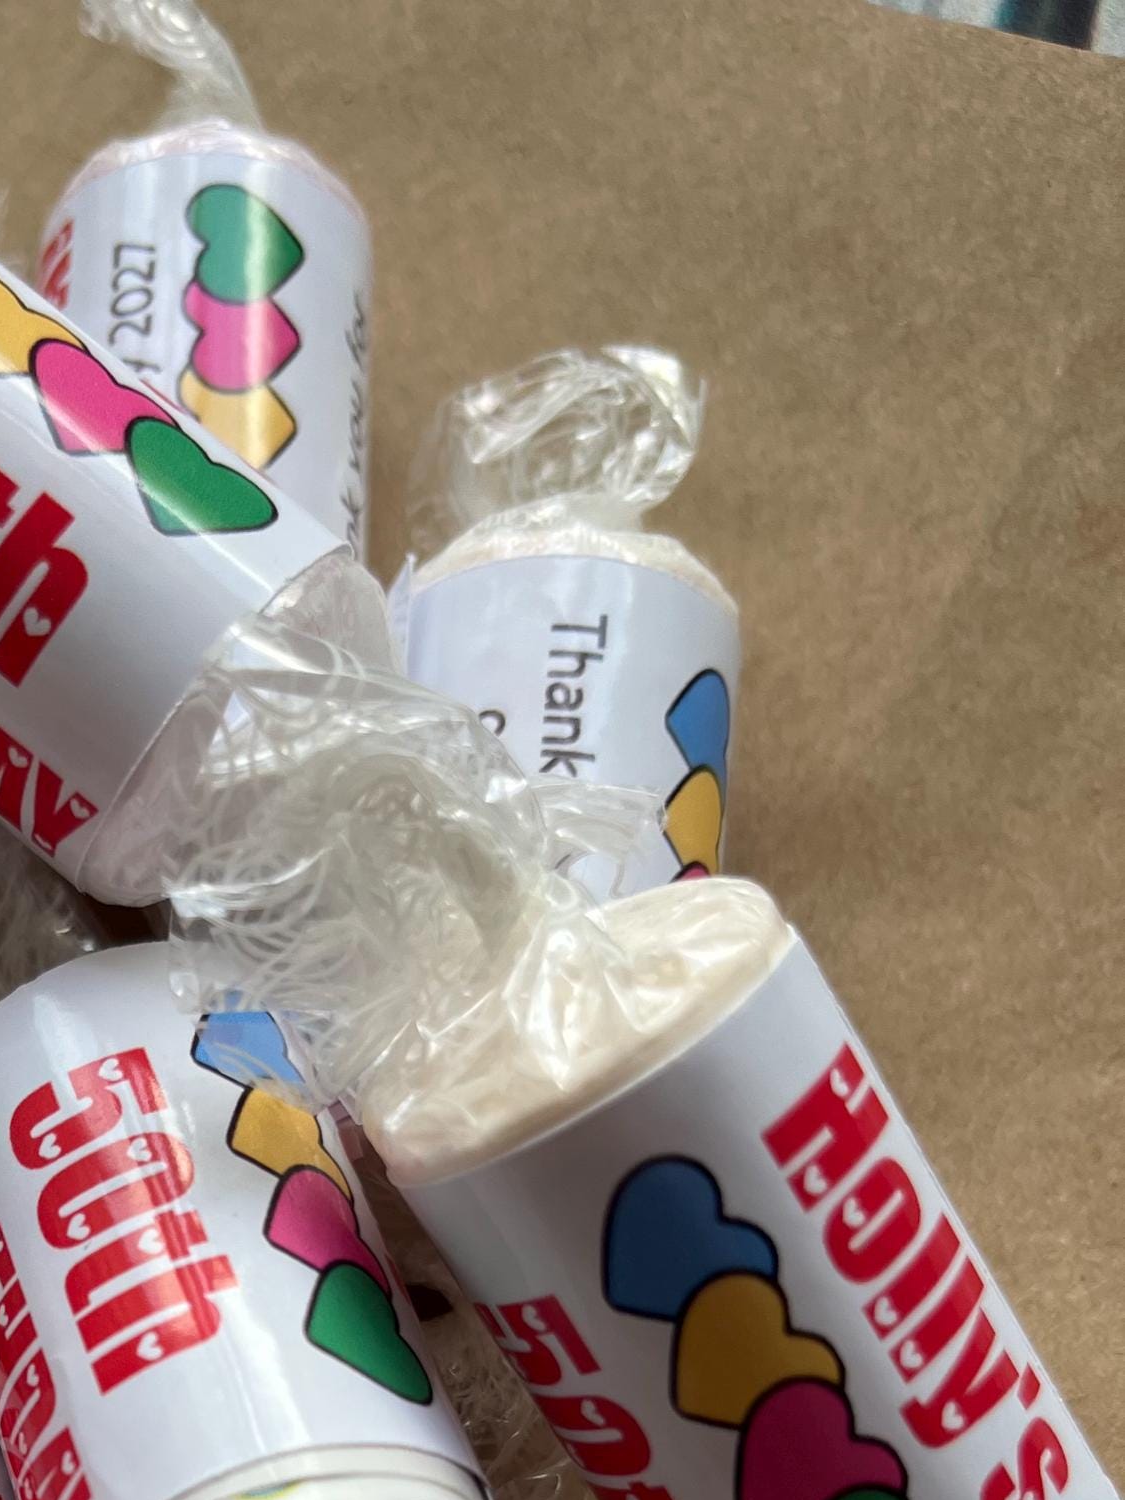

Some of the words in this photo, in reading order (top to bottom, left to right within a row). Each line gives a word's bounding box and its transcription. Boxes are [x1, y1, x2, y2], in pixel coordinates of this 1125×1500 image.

[108, 241, 157, 345] 2027
[539, 614, 608, 778] Thank
[10, 1047, 240, 1396] 50th
